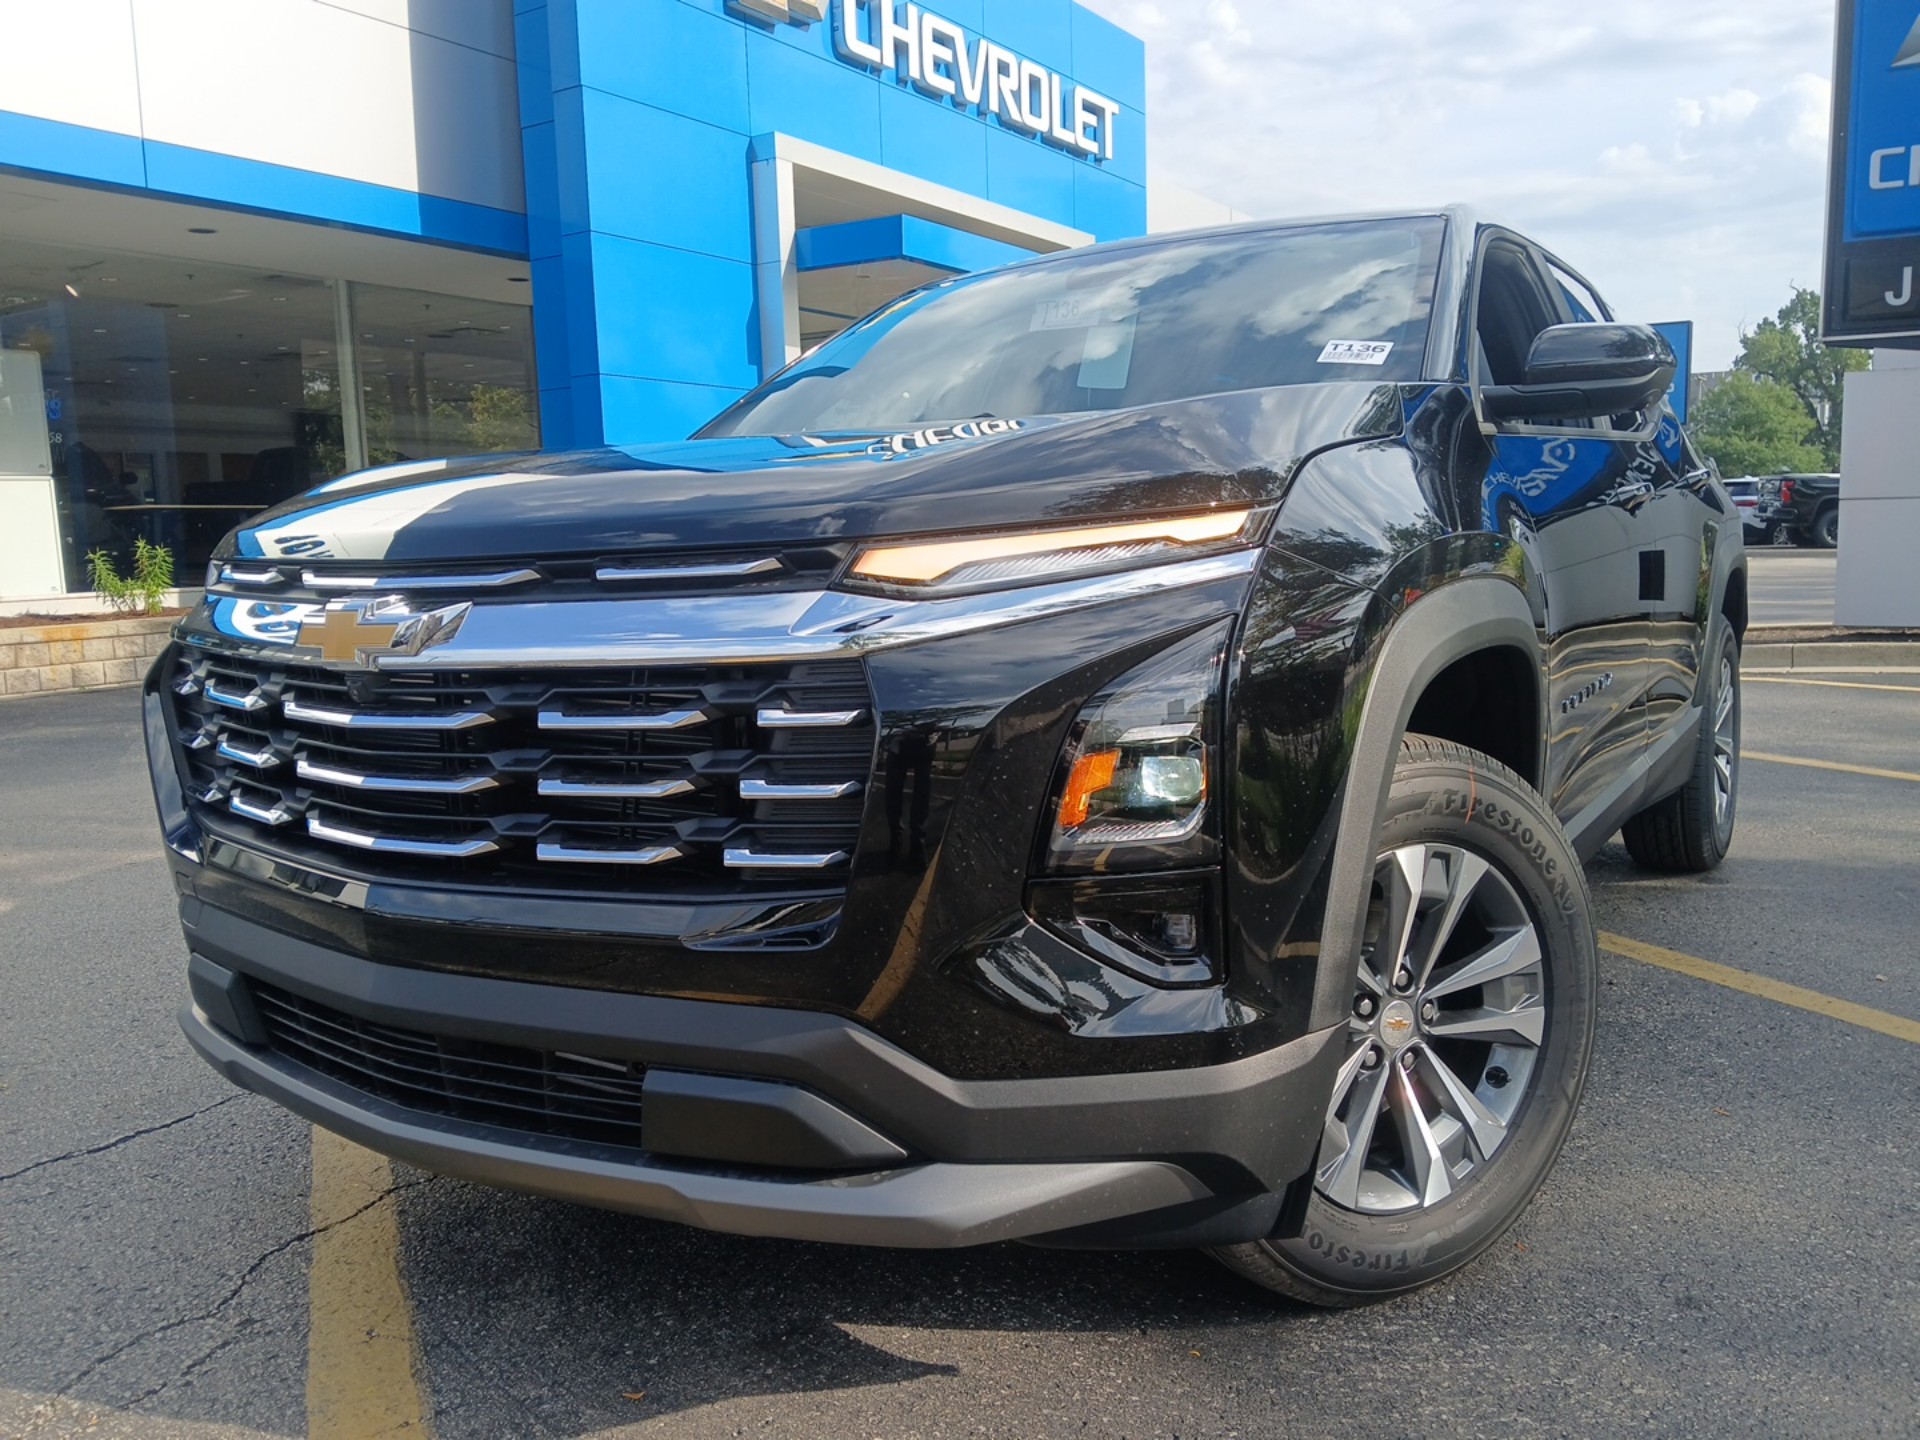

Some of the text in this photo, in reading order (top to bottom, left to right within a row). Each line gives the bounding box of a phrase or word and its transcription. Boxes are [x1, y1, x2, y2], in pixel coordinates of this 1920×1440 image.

[840, 0, 1119, 161] CHEVROLET
[1331, 343, 1388, 354] T136
[1442, 788, 1558, 876] Firestone
